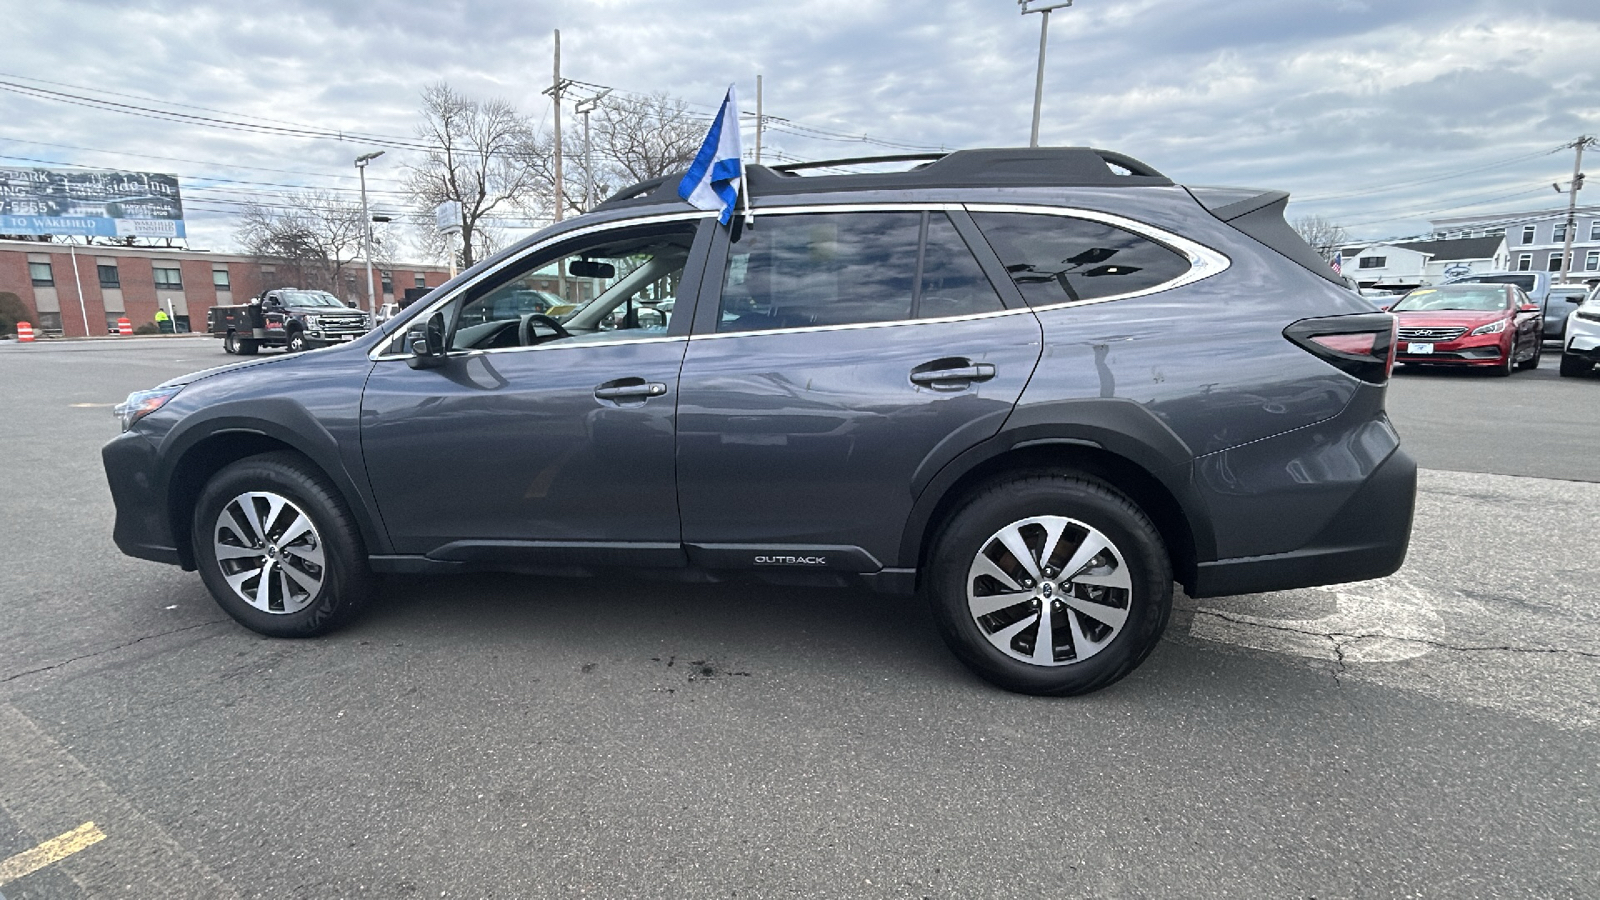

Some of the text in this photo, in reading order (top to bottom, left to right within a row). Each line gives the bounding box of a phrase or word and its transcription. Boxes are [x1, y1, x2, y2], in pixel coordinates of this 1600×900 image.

[9, 171, 50, 183] PARK
[11, 217, 27, 227] TO
[32, 217, 96, 228] WAKEFIELD
[754, 555, 826, 565] OUTBACK
